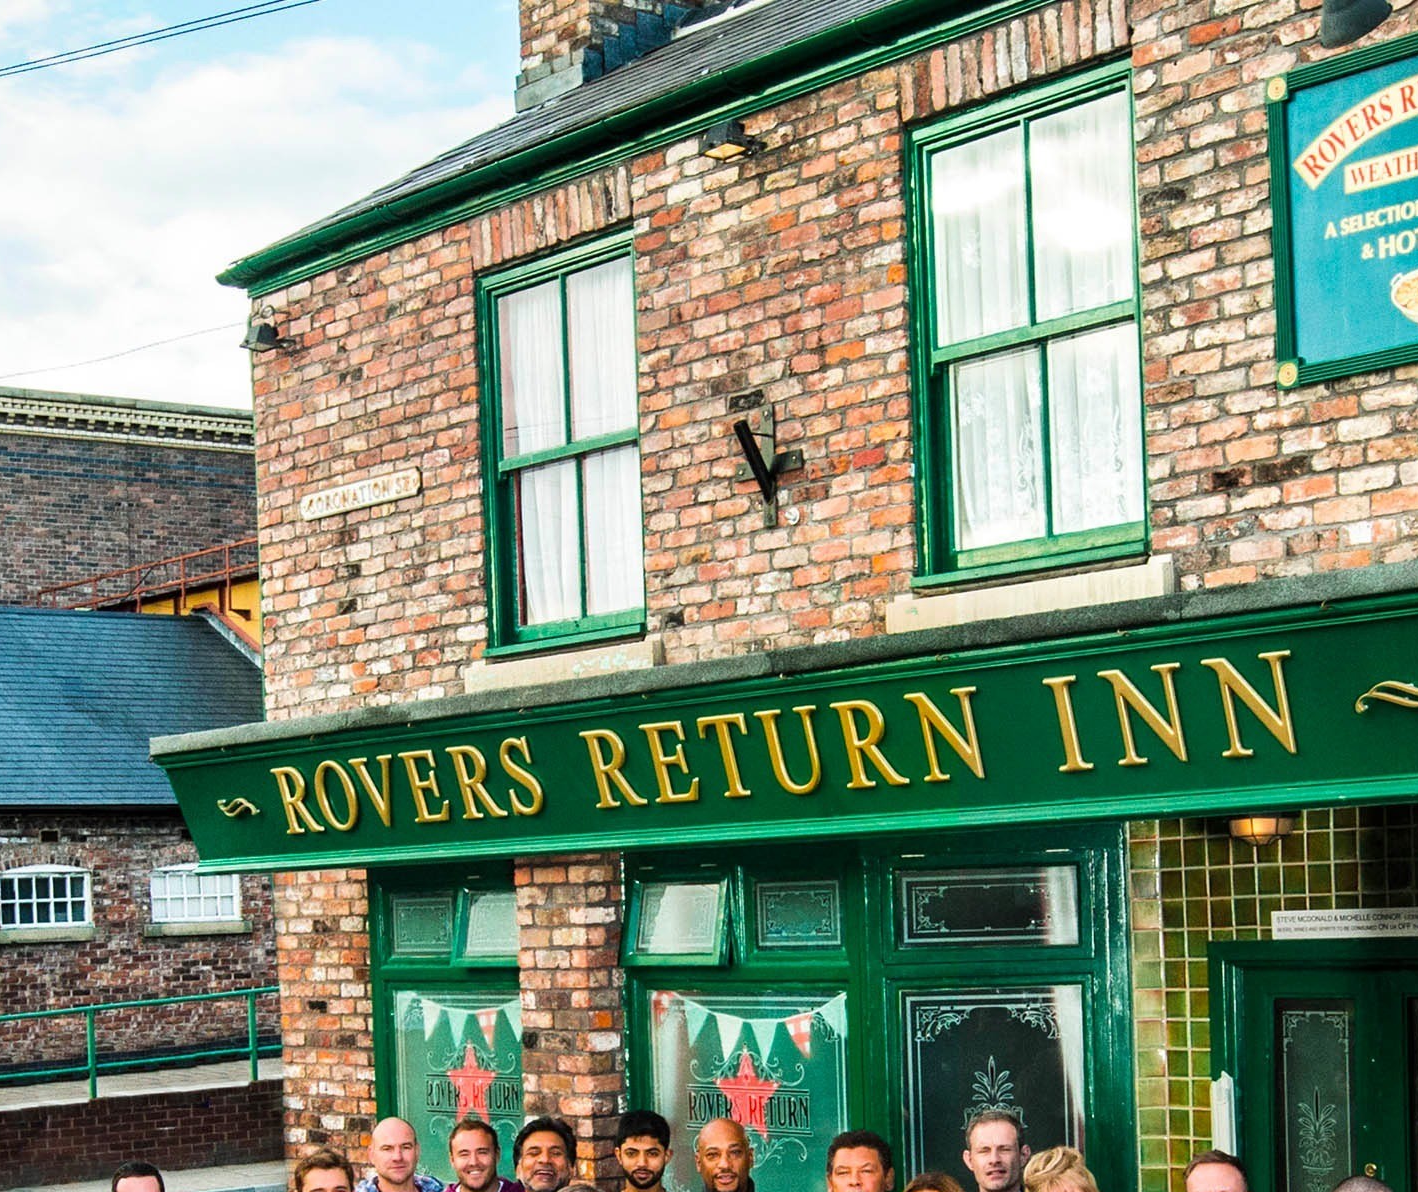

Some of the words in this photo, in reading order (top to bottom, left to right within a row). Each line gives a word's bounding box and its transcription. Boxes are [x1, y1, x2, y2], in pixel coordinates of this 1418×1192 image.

[1302, 92, 1394, 180] ROVERS
[1324, 222, 1338, 240] A
[1361, 244, 1374, 260] &
[269, 735, 544, 835] ROVERS
[579, 685, 985, 811] RETURN
[1042, 650, 1298, 773] INN
[426, 1079, 468, 1108] ROVERS
[472, 1081, 520, 1111] RETURN
[687, 1091, 743, 1124] ROVERS
[748, 1094, 810, 1130] RETURN
